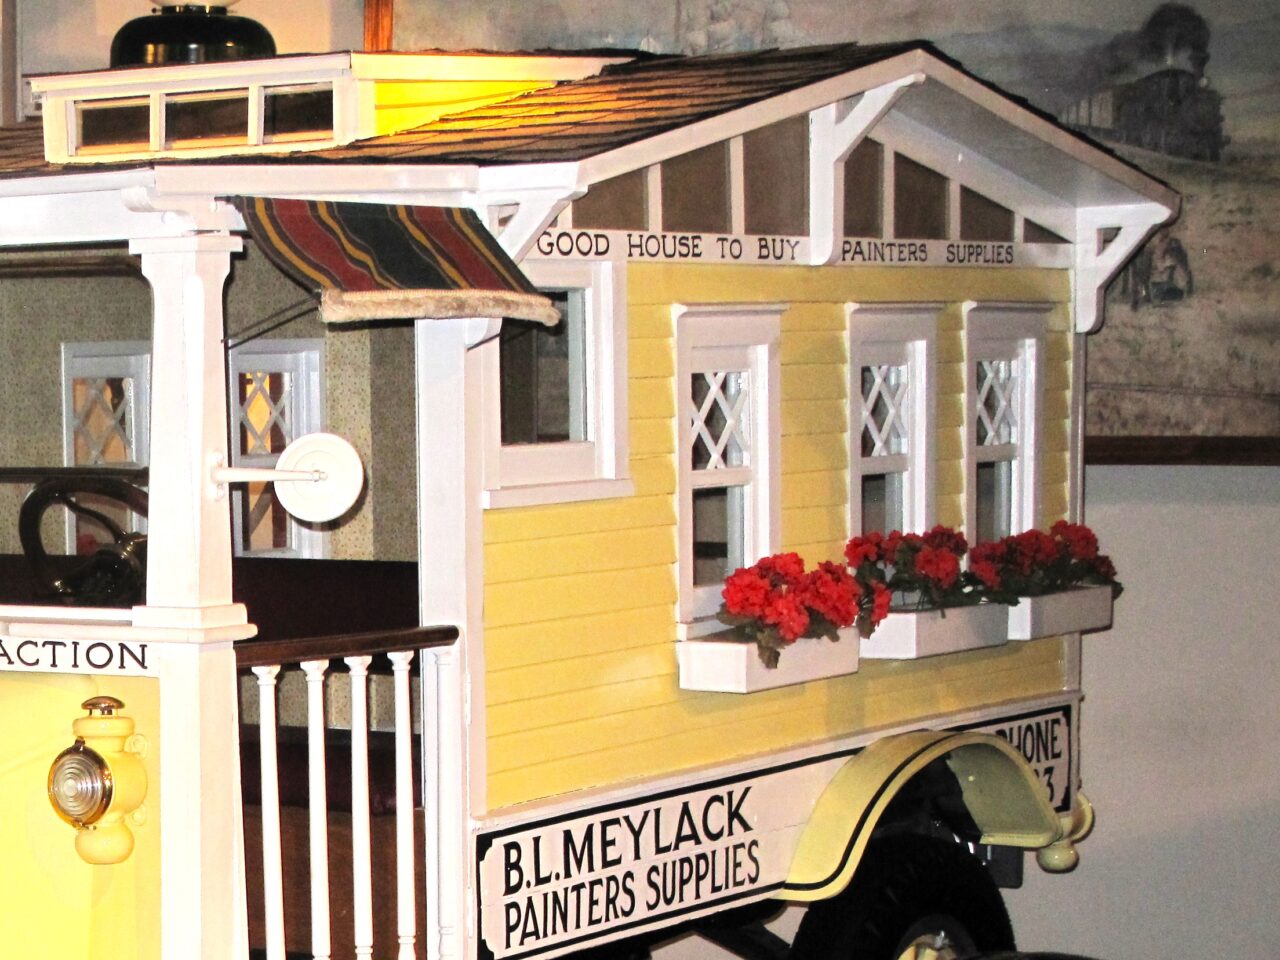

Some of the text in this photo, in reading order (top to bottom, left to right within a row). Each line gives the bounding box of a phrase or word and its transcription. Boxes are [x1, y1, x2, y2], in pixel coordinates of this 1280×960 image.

[536, 231, 1014, 264] GOOD HOUSE TO BUY PAINTERS SUPPLIES
[994, 717, 1063, 764] HONE
[503, 839, 761, 949] PAINTERS SUPPLIES
